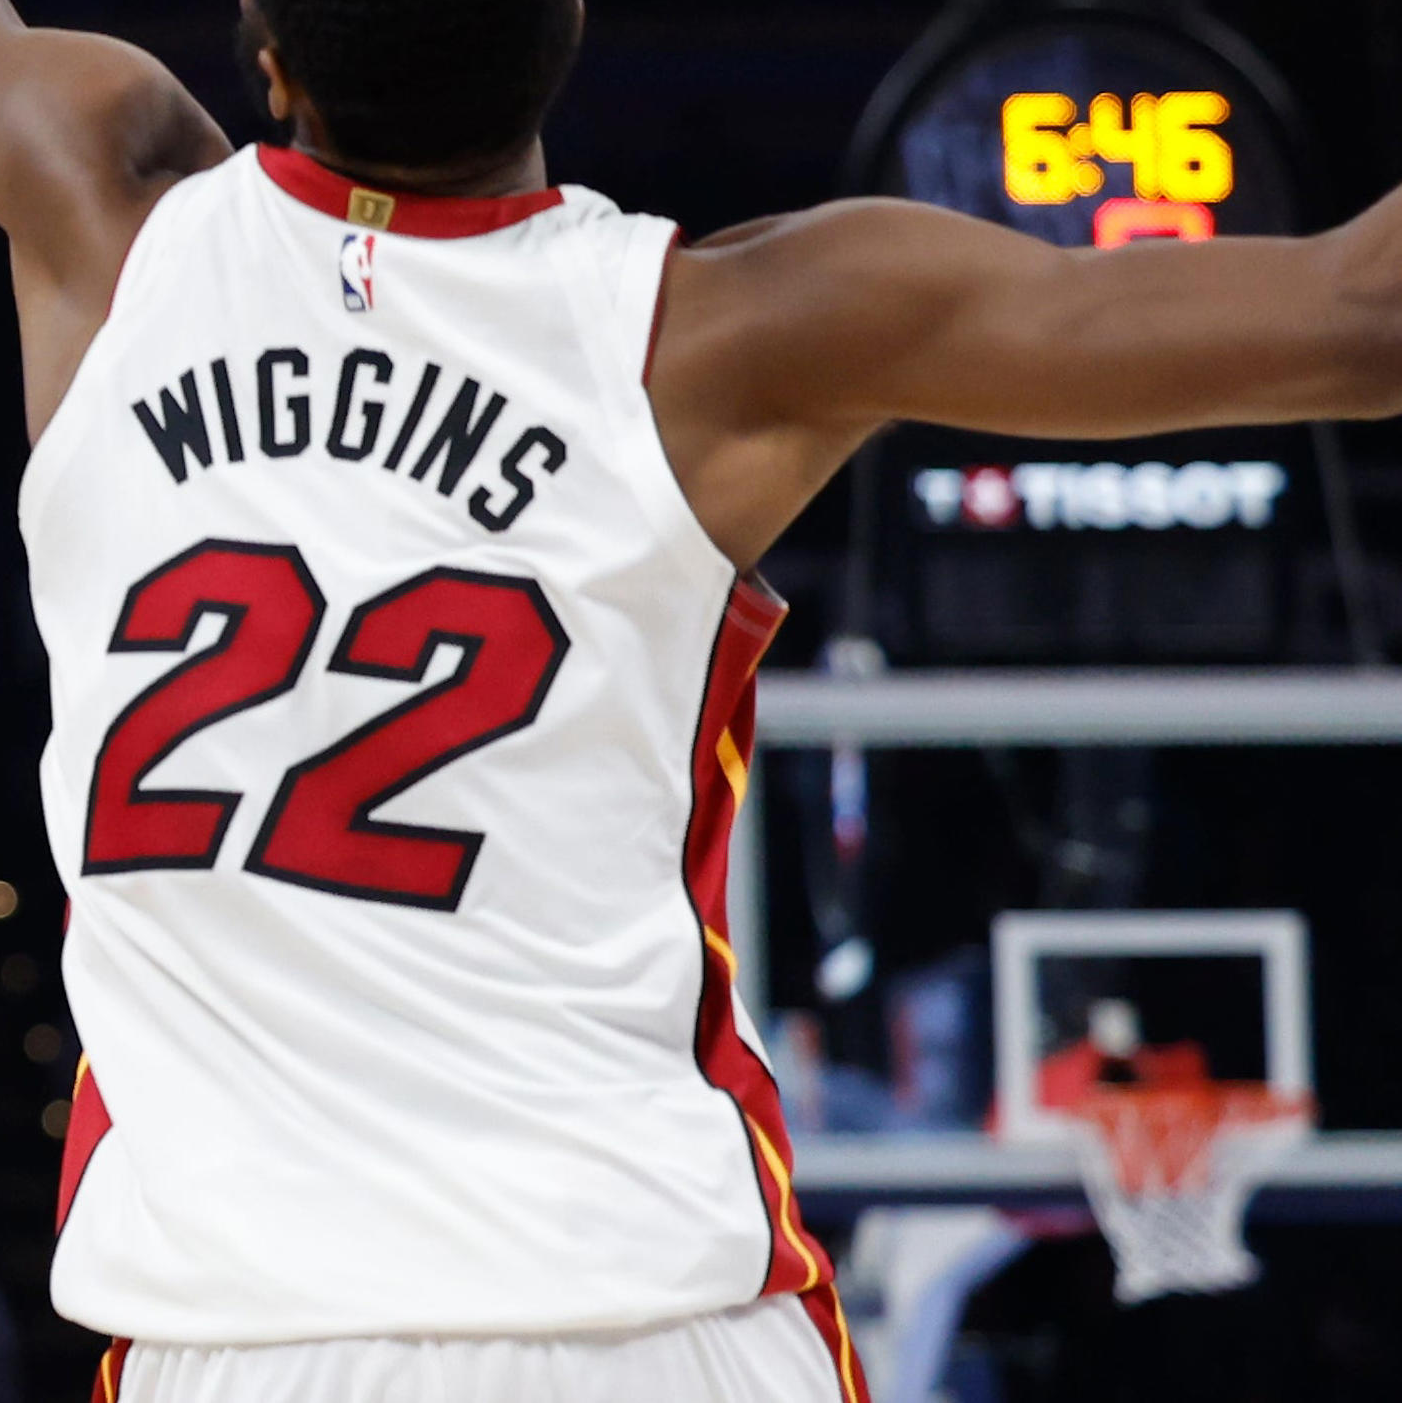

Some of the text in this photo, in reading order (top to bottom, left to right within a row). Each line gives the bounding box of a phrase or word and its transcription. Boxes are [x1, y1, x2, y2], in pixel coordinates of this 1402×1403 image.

[1002, 91, 1233, 205] 6:46
[131, 347, 567, 533] WIGGINS
[81, 537, 571, 913] 22
